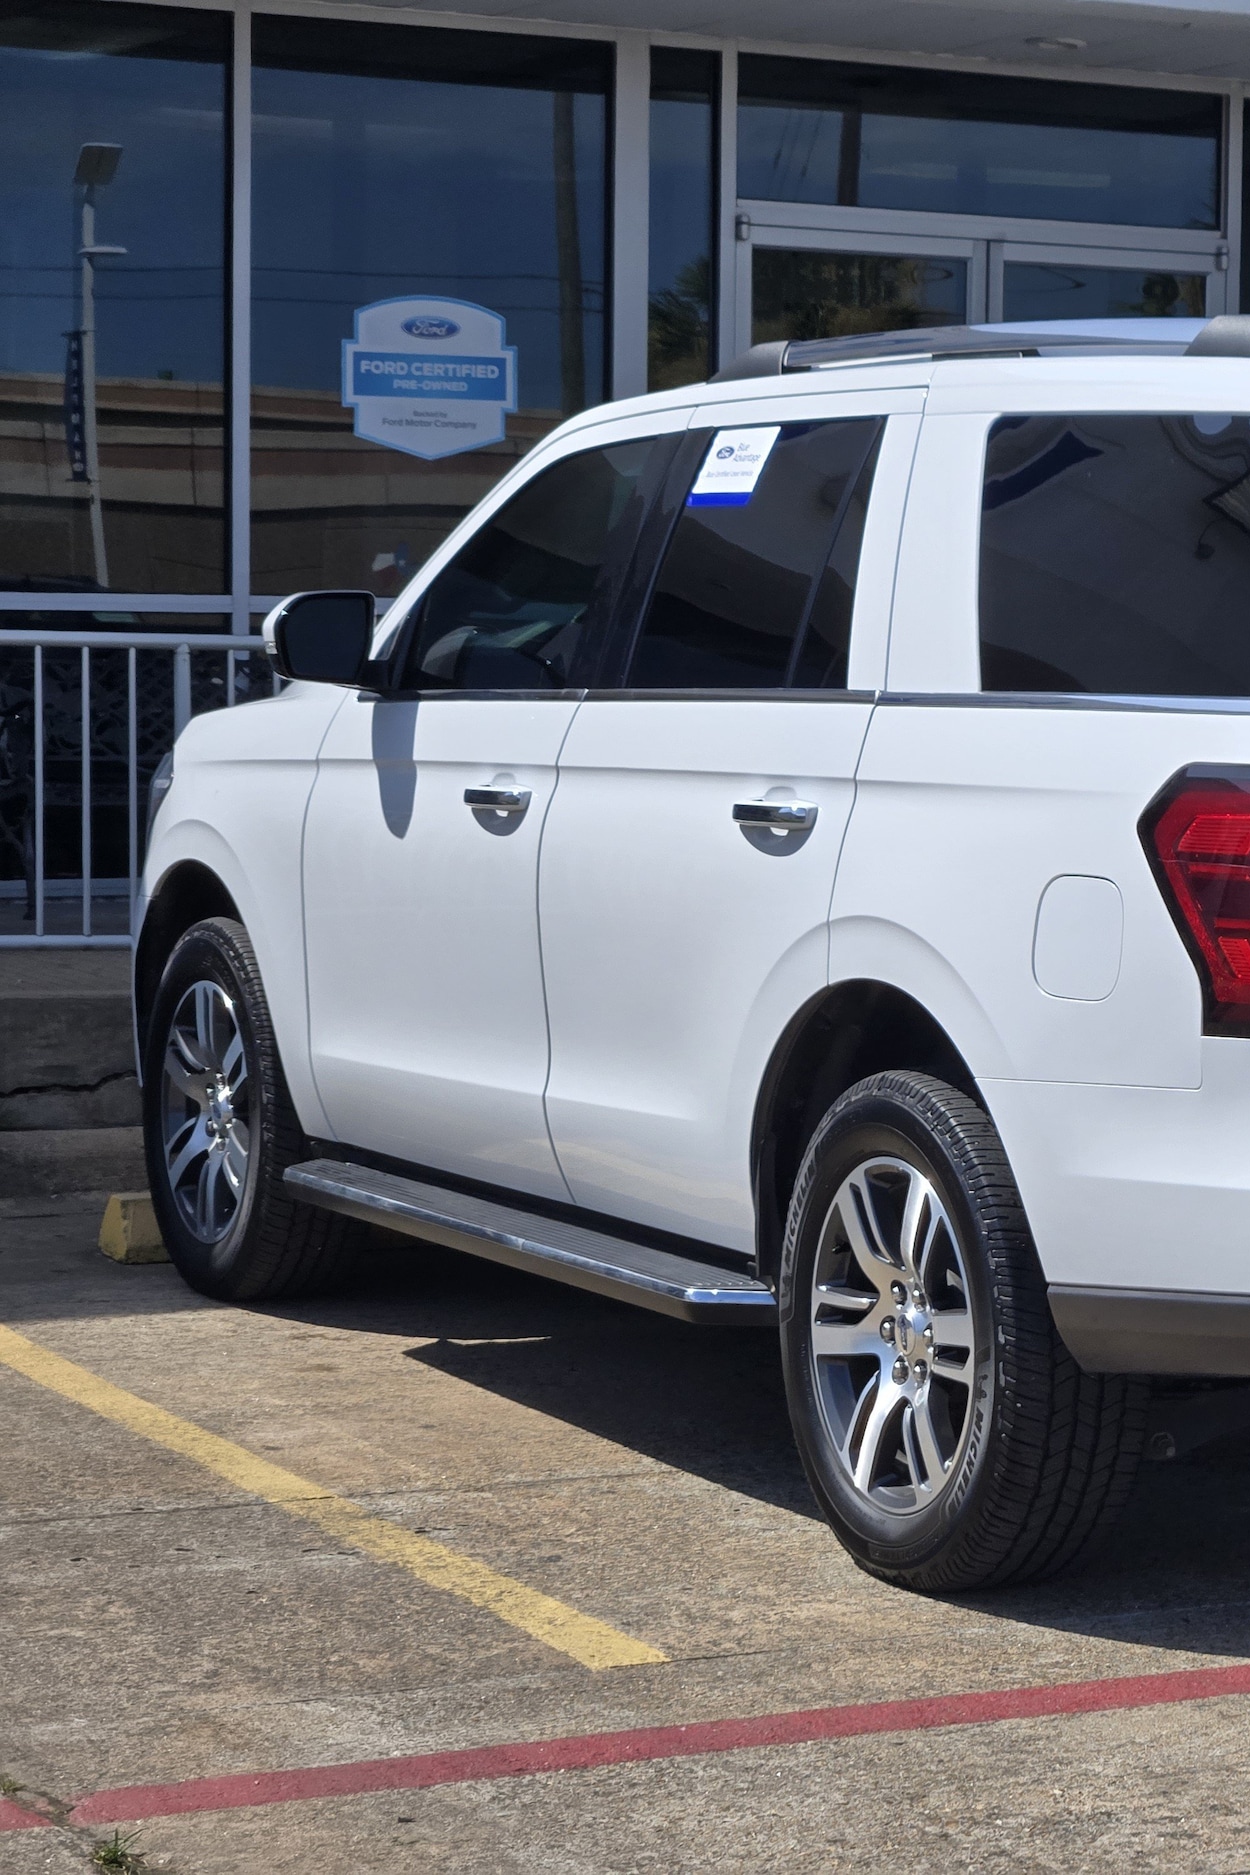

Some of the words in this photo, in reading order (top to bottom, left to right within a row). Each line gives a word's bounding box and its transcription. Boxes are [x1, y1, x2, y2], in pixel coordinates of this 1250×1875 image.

[412, 319, 448, 336] Ford
[360, 360, 408, 375] FORD
[410, 362, 500, 379] CERTIFIED
[393, 380, 468, 392] PRE-OWNED
[382, 418, 403, 427] Ford
[405, 419, 432, 428] Motor
[434, 420, 477, 430] Company
[784, 1159, 816, 1270] MICHELIN
